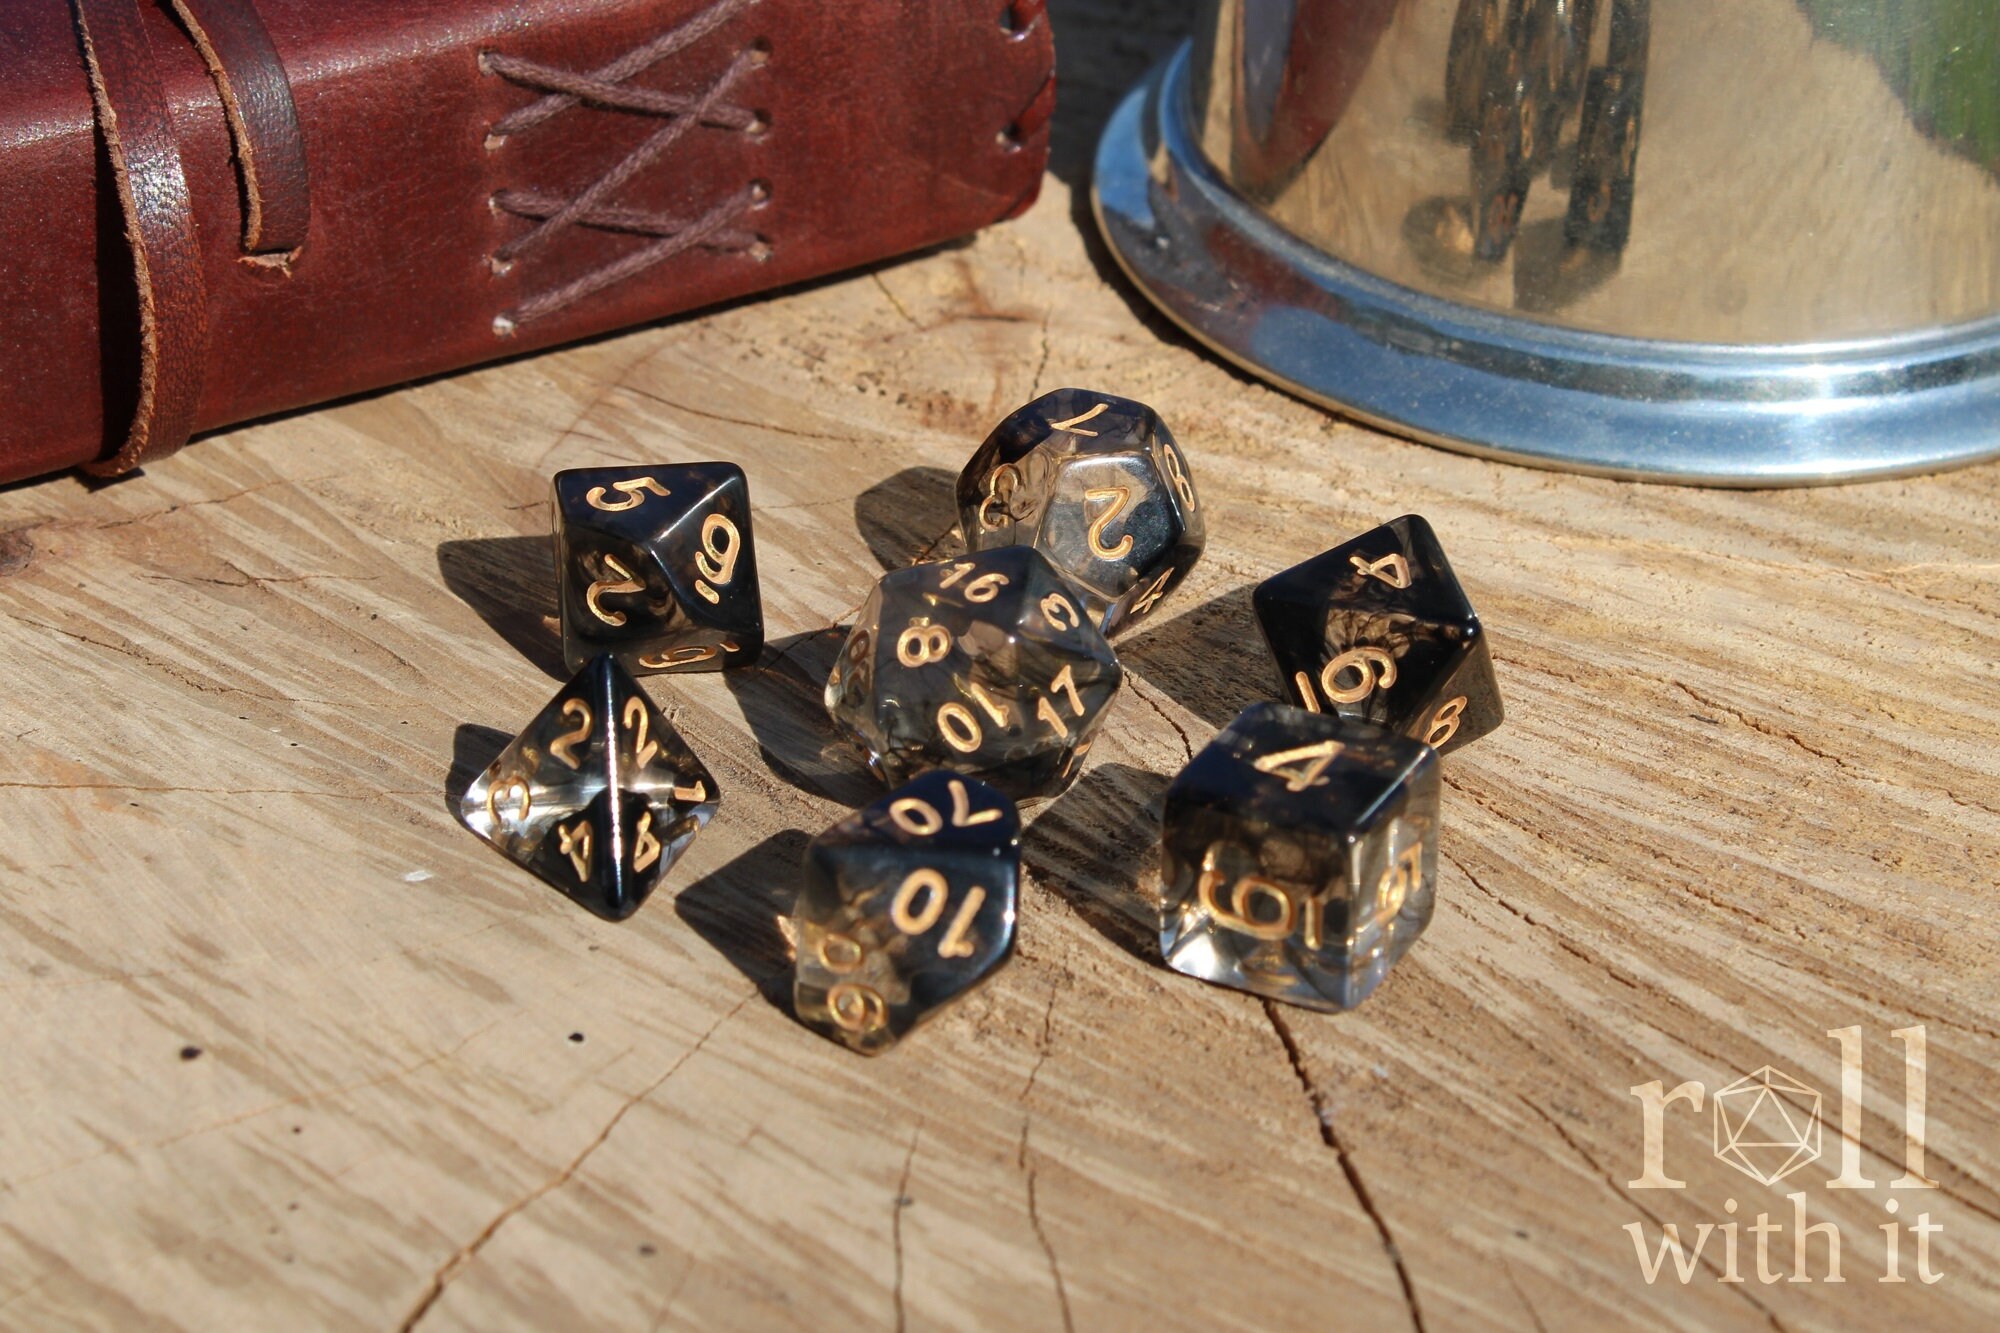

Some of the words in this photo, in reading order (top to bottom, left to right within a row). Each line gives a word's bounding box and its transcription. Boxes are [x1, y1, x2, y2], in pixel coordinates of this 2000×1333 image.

[586, 476, 671, 512] 5
[1163, 443, 1195, 512] 8
[1084, 485, 1133, 560] 2
[585, 553, 646, 627] 2
[938, 561, 1010, 603] 16
[1349, 553, 1412, 589] 4
[1039, 592, 1079, 631] 3
[896, 623, 951, 668] 8
[936, 682, 1009, 753] 10
[1037, 663, 1085, 738] 17
[1422, 695, 1468, 749] 8
[549, 698, 594, 770] 2
[623, 696, 658, 769] 2
[1253, 739, 1346, 792] 4
[486, 774, 530, 826] 3
[557, 820, 594, 882] 4
[633, 811, 662, 873] 4
[892, 867, 987, 958] 10
